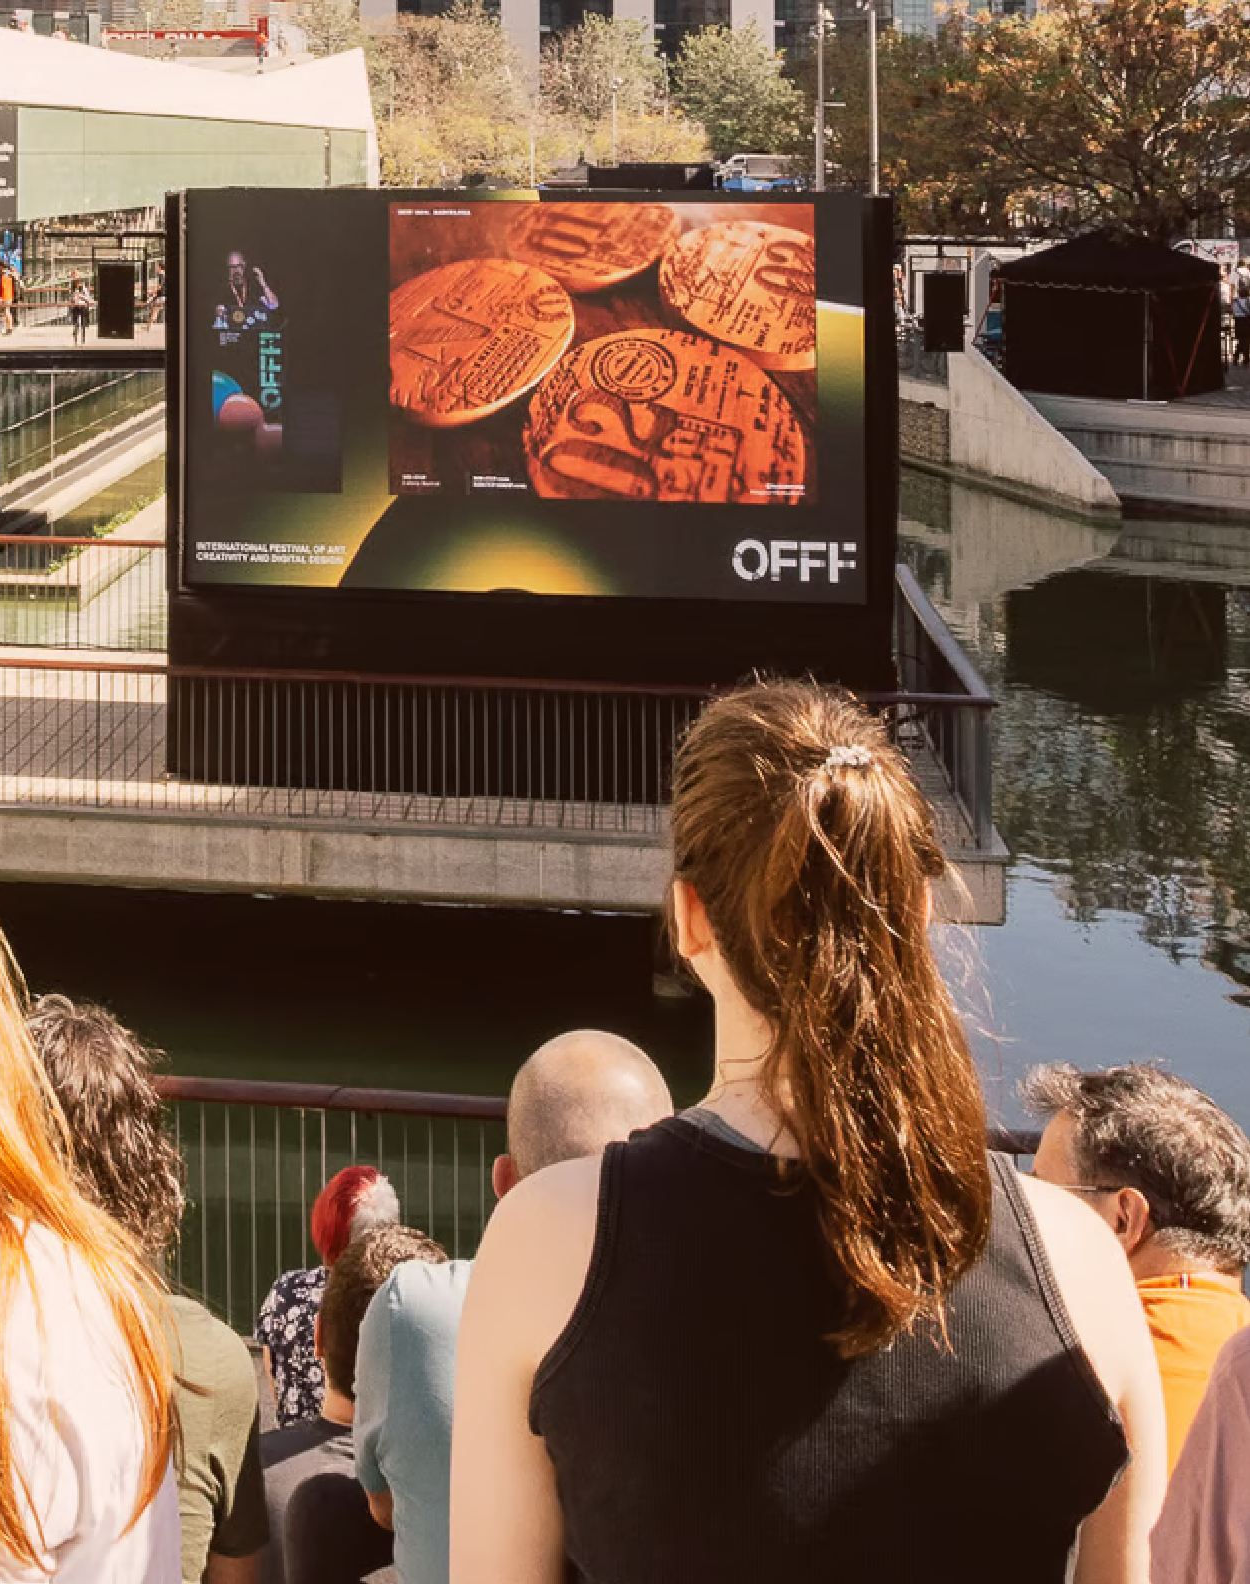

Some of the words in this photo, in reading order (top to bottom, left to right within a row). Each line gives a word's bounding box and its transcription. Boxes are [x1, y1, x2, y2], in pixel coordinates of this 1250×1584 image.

[195, 541, 268, 553] INTERNATIONAL
[269, 543, 311, 555] FESTIVAL
[313, 545, 326, 555] OF
[195, 551, 250, 562] CREATIVITY
[250, 553, 270, 563] AND
[271, 554, 307, 564] DIGITAL
[309, 555, 344, 565] DESIGN
[732, 537, 857, 583] OFFF
